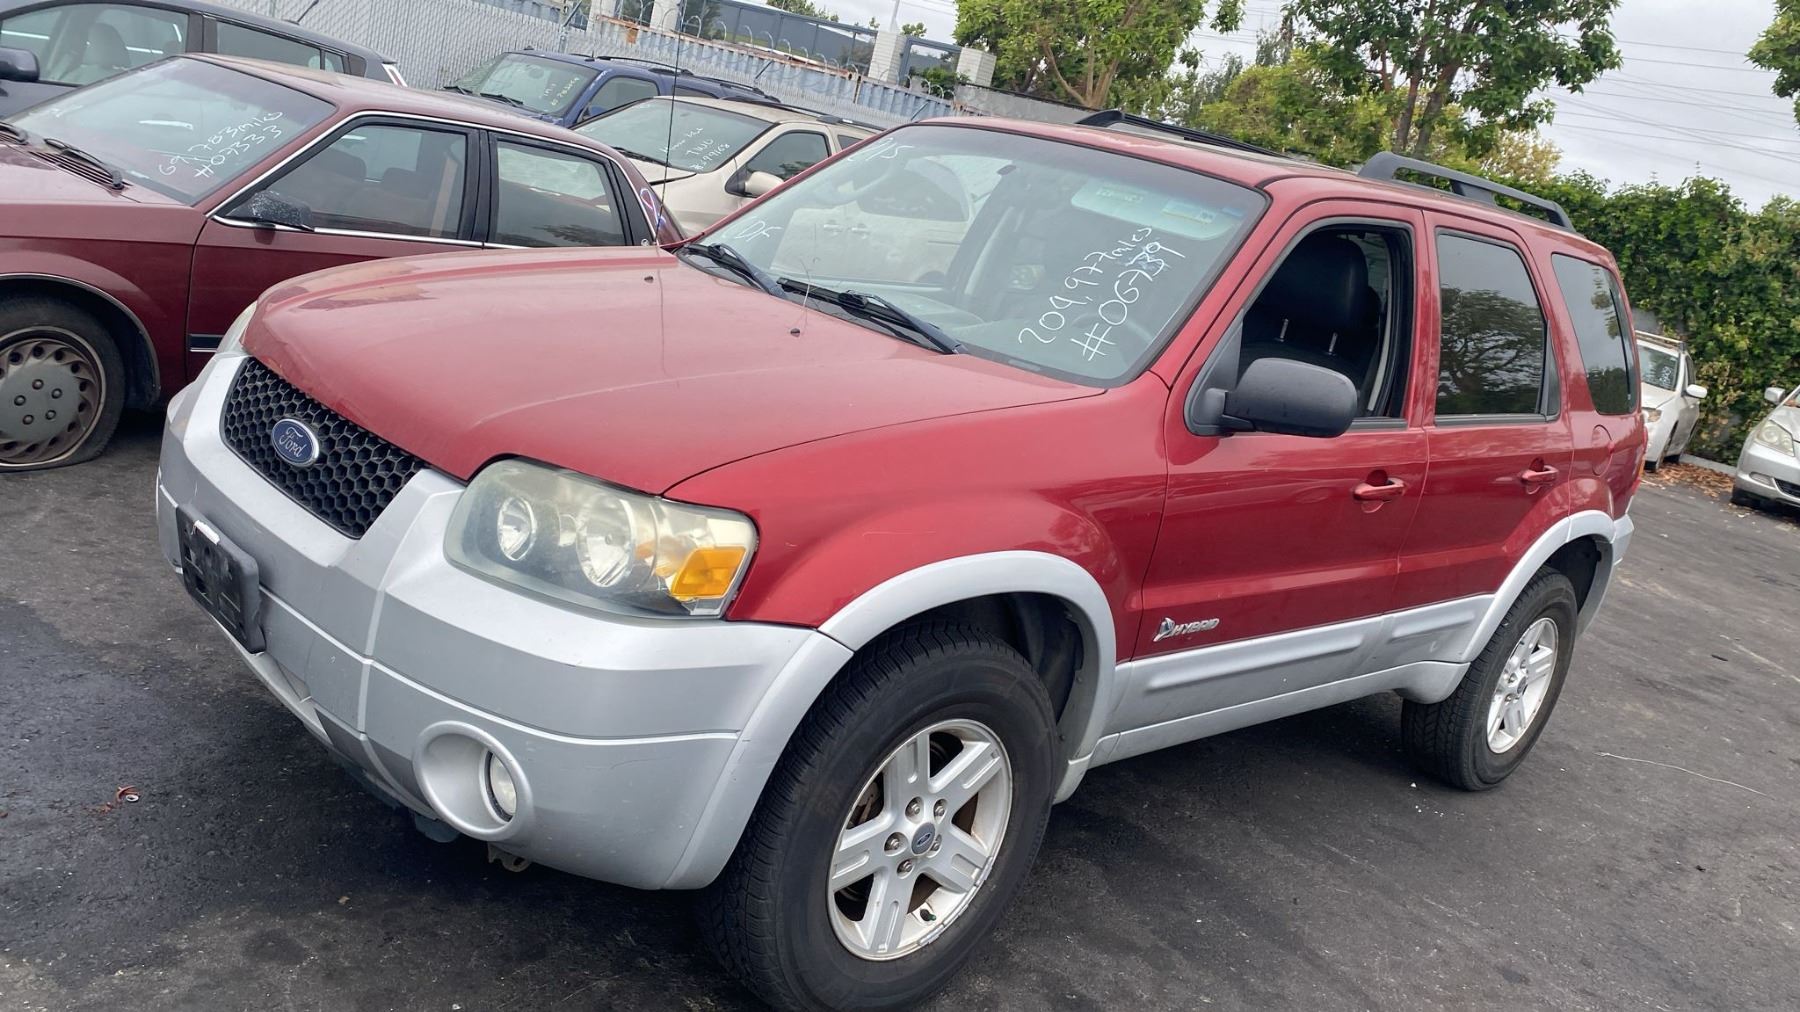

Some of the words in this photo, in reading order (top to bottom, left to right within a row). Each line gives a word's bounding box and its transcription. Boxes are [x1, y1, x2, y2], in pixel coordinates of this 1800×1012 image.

[1070, 241, 1186, 361] #06739
[279, 426, 307, 457] Ford
[1170, 618, 1220, 637] HYBRID
